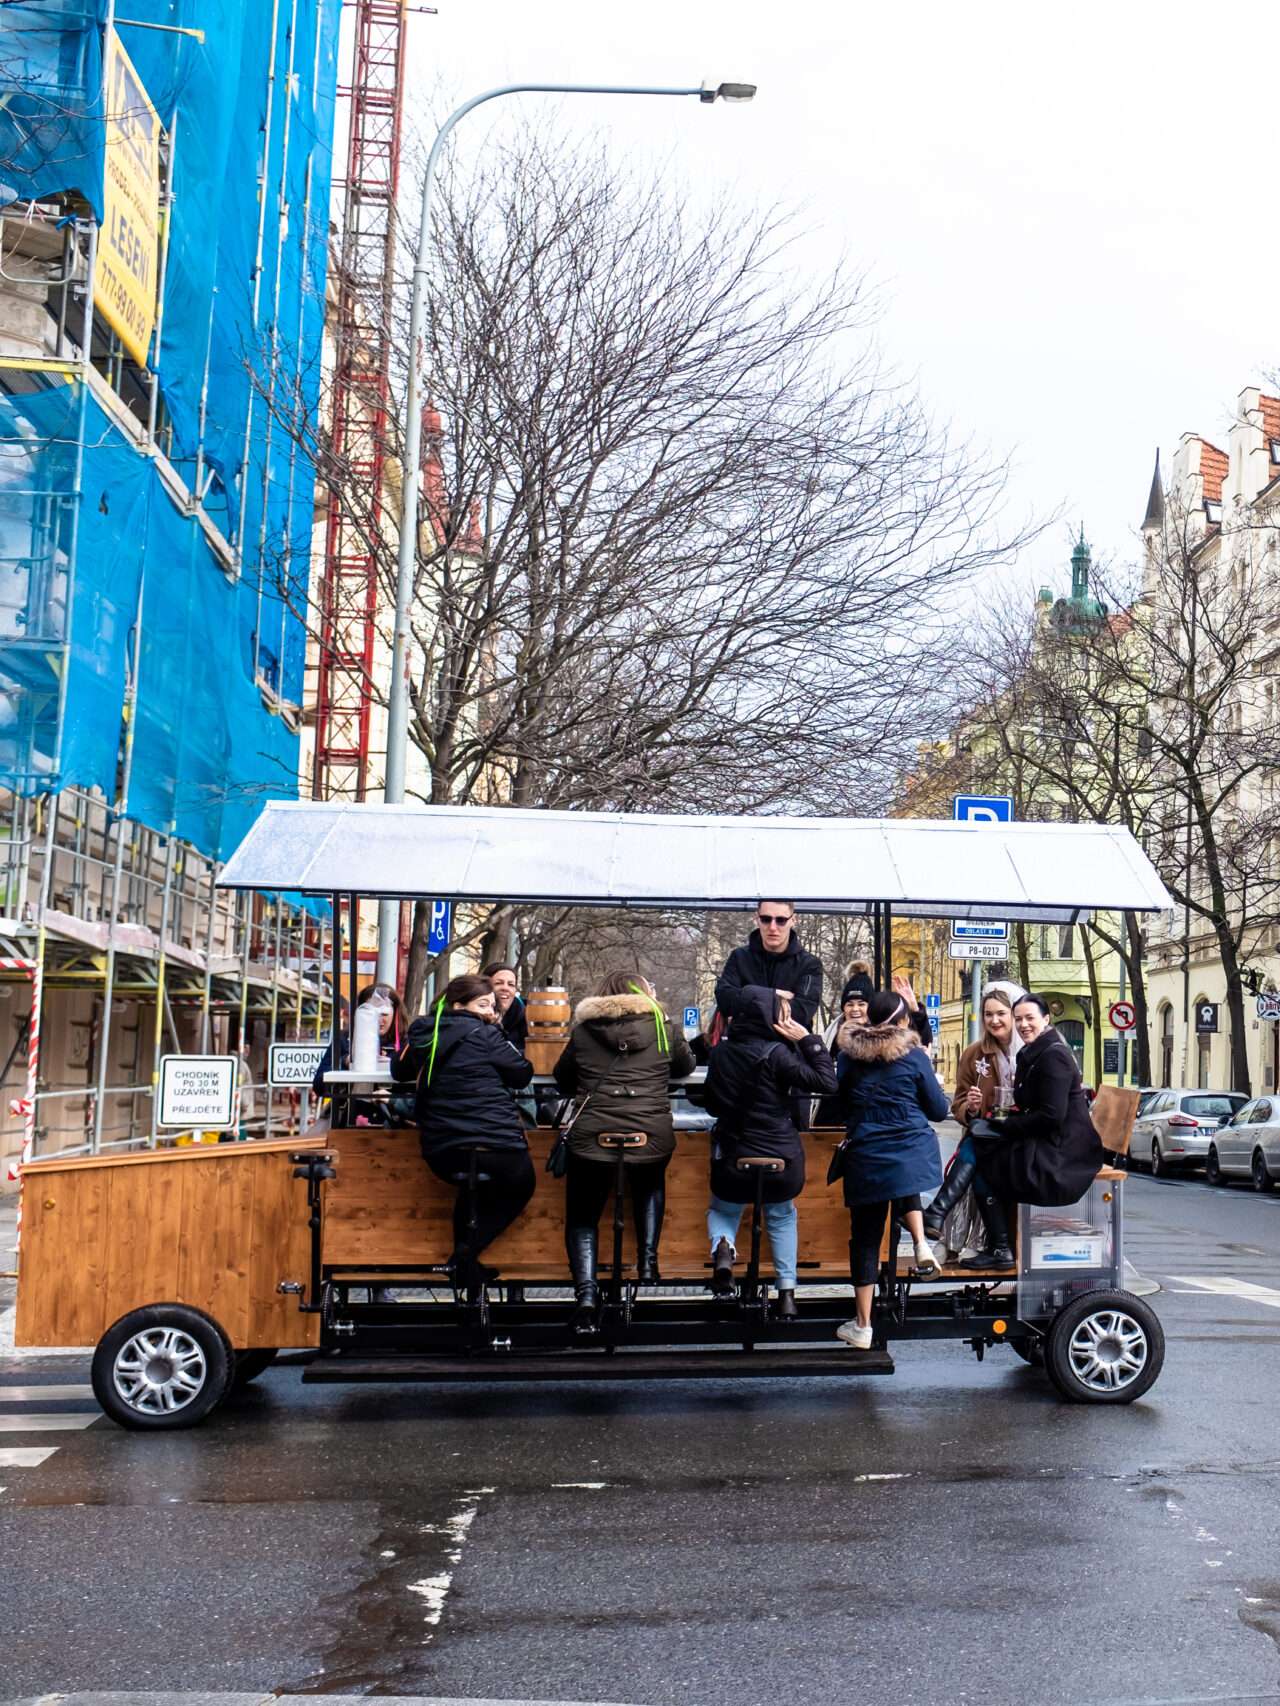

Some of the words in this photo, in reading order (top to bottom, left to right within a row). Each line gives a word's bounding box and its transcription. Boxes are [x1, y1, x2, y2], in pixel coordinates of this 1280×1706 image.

[110, 204, 150, 293] LEŠENÍ
[431, 901, 446, 933] P
[969, 946, 1000, 956] P8-0212
[687, 1010, 696, 1021] P
[277, 1052, 324, 1064] CHODNÍ
[174, 1071, 220, 1079] CHODNÍK
[277, 1066, 317, 1078] UZAVŘ
[173, 1087, 220, 1096] UZAVŘEN
[172, 1103, 223, 1114] PŘEJDĚTE
